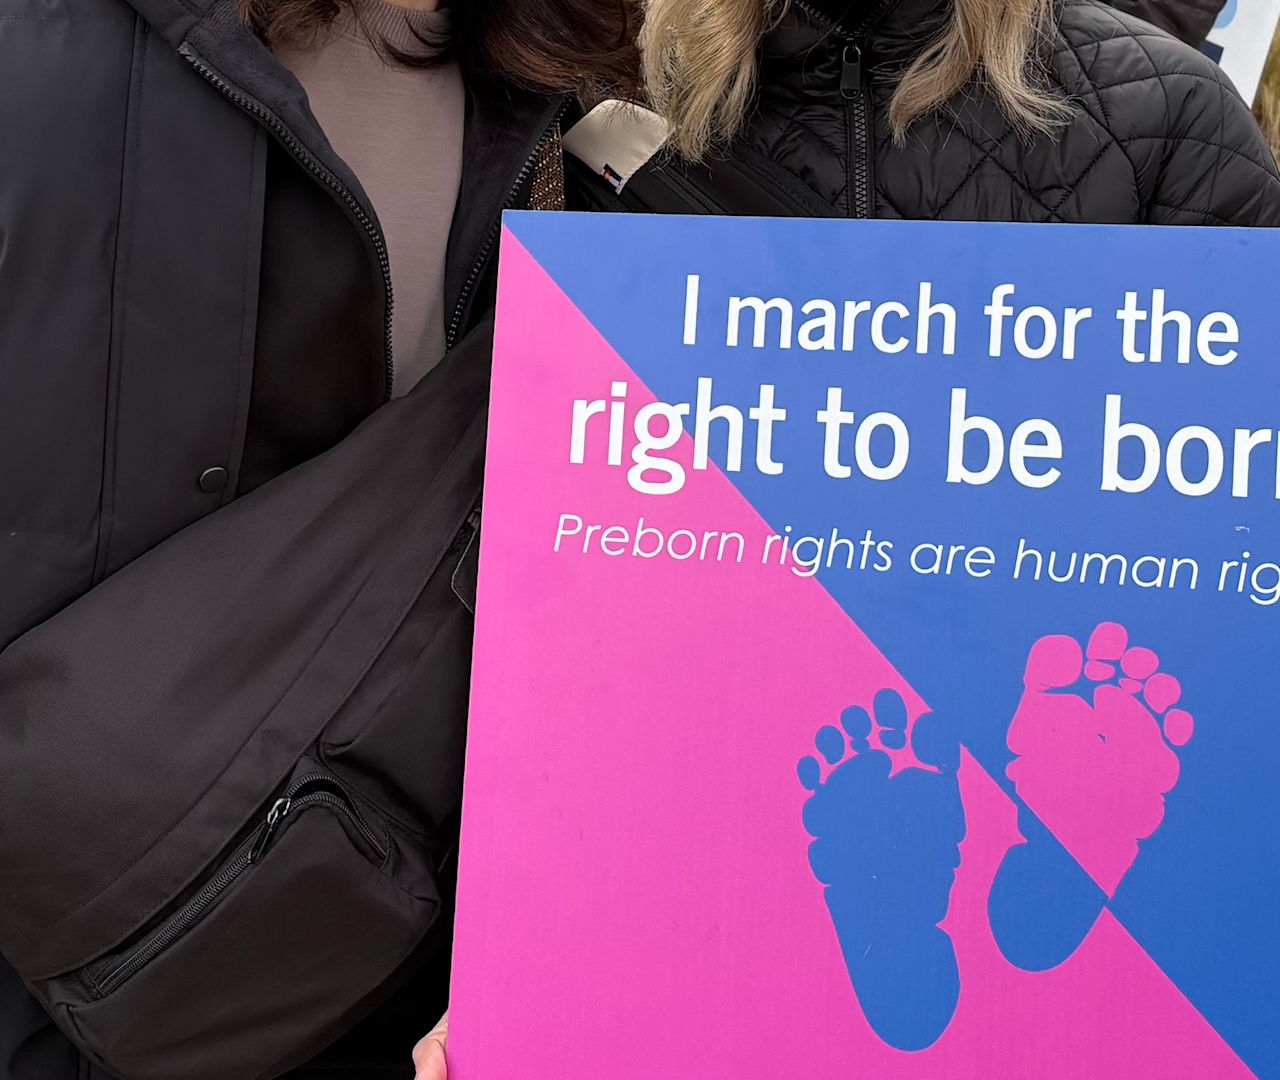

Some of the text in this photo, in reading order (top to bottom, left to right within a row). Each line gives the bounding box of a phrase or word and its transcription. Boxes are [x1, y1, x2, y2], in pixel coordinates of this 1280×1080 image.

[684, 274, 1239, 366] I march for the
[569, 377, 786, 495] right
[817, 388, 909, 481] to
[946, 388, 1063, 488] be
[554, 514, 745, 562] Preborn
[762, 525, 893, 577] rights
[910, 541, 995, 577] are
[1013, 538, 1198, 589] human
